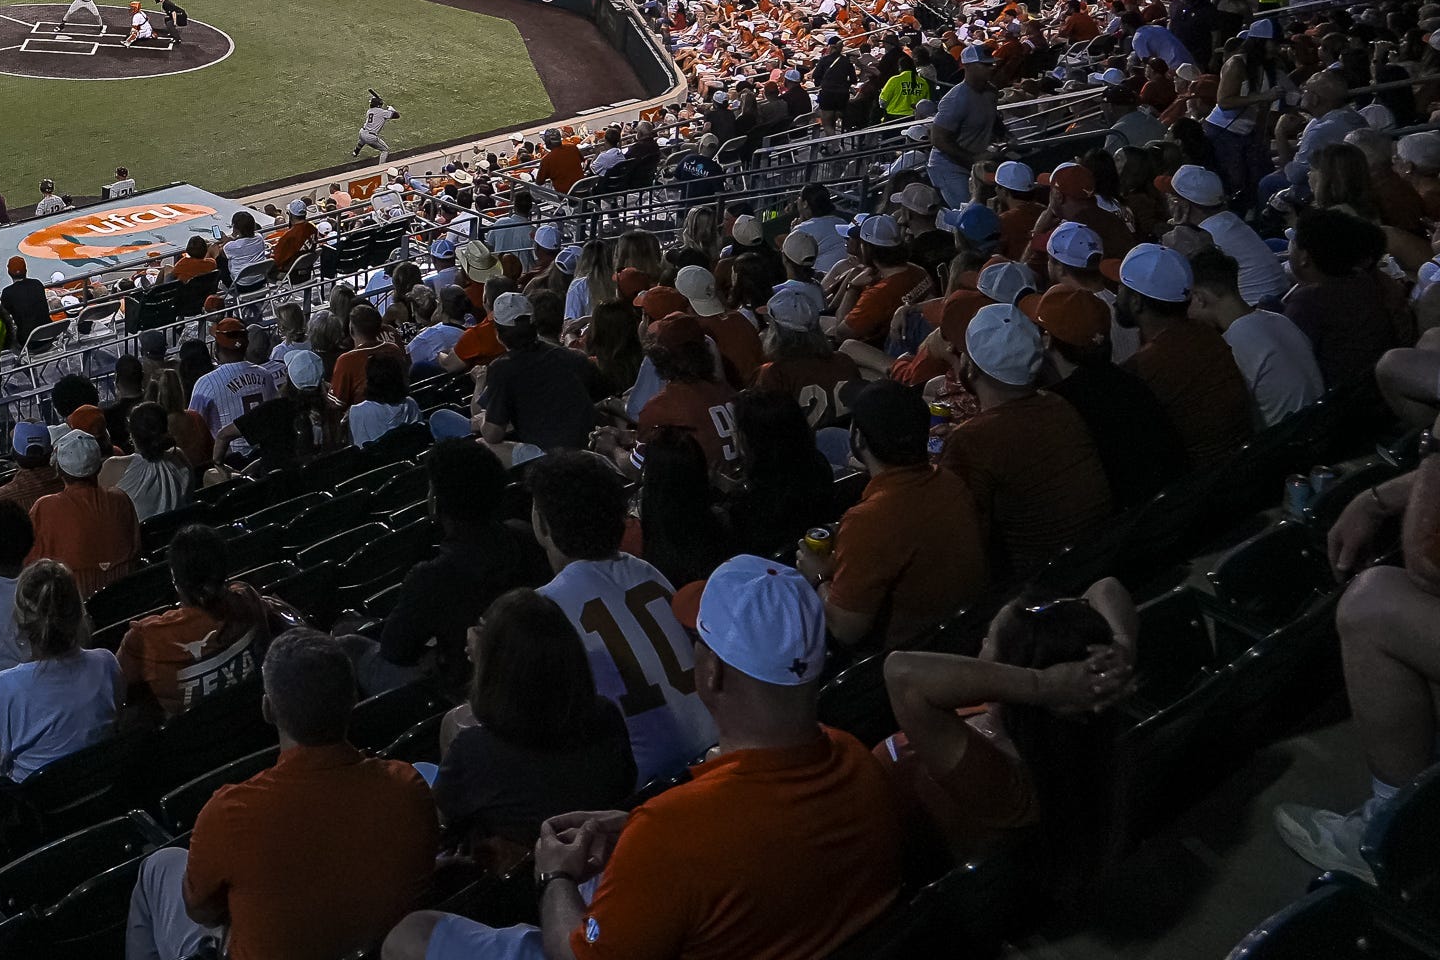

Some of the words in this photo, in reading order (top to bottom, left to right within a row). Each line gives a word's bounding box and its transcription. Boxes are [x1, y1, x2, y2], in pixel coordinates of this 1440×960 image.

[901, 81, 923, 89] EVNT
[368, 113, 374, 123] 8
[86, 204, 182, 234] ufcu
[226, 372, 266, 394] MENDOZA
[579, 580, 697, 718] 10
[179, 649, 256, 709] TEXA
